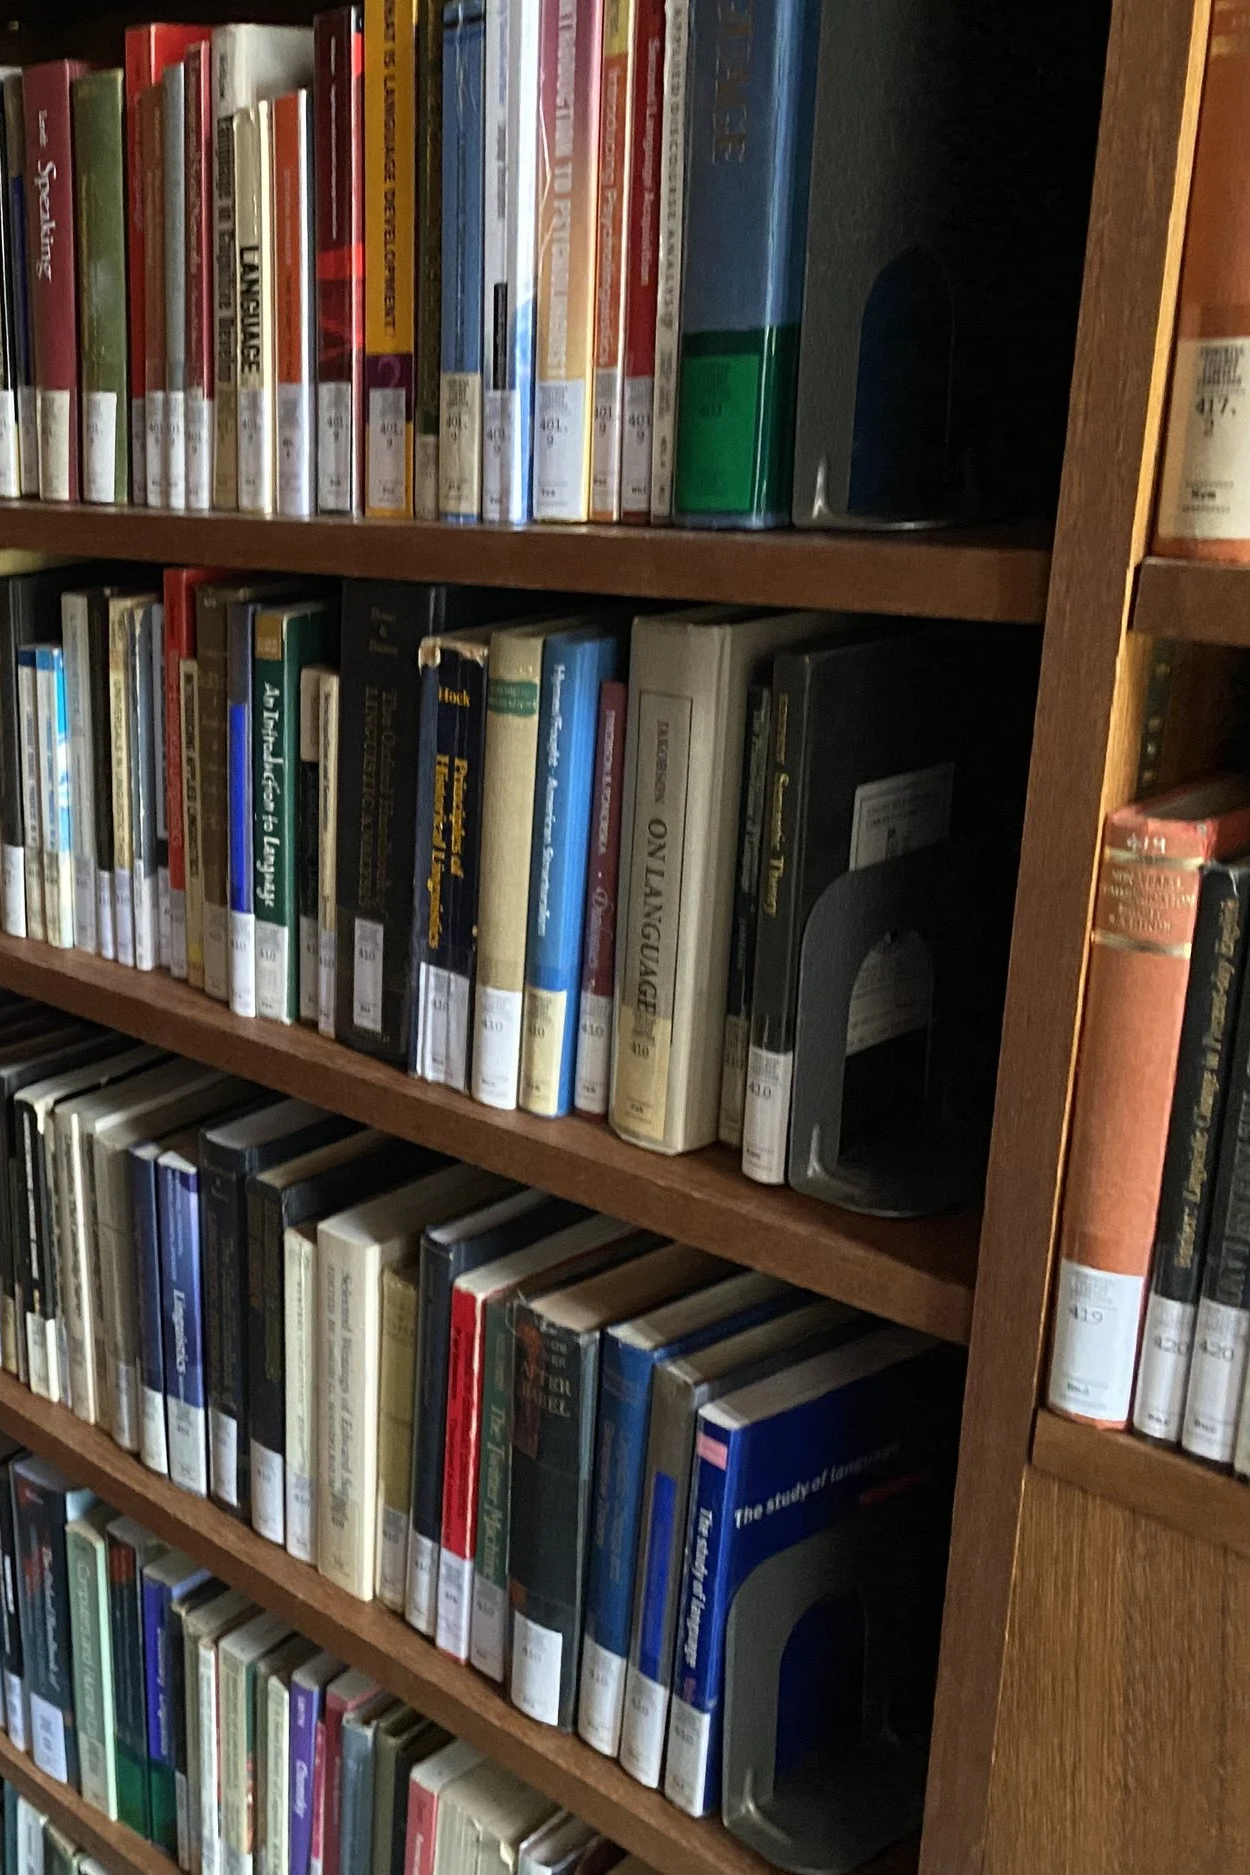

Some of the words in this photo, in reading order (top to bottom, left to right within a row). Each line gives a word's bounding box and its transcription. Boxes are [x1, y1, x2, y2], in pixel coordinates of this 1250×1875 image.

[215, 115, 234, 200] Language
[383, 75, 396, 181] LANGUAGE
[602, 67, 620, 186] Introducing
[642, 105, 657, 189] Language
[33, 159, 57, 284] Speaking
[640, 191, 655, 286] Acquisition
[217, 228, 235, 308] Cognitive
[383, 191, 396, 329] DEVELOPMENT
[597, 187, 617, 366] Psycholinguistics
[240, 245, 260, 374] LANGUAGE
[264, 682, 281, 709] An
[381, 689, 397, 724] The
[261, 709, 284, 812] Introduction
[362, 686, 378, 808] LINGUISTIC
[380, 730, 397, 794] Oxford
[653, 721, 670, 805] JAKOBSON
[261, 814, 279, 833] to
[431, 754, 450, 850] Historical
[448, 755, 468, 854] Principles
[770, 771, 790, 852] Semantic
[259, 835, 281, 908] Language
[376, 800, 395, 897] Handbook
[450, 853, 464, 879] of
[646, 818, 667, 864] ON
[426, 849, 445, 950] Linguistics
[763, 854, 785, 918] Theory
[358, 948, 375, 961] 410
[633, 866, 665, 1018] LANGUAGE
[1214, 899, 1241, 958] English
[481, 1018, 504, 1032] 410
[581, 1023, 605, 1037] 410
[631, 1043, 650, 1057] 410
[748, 1081, 772, 1098] 410
[1194, 1070, 1221, 1128] Change
[1183, 1130, 1210, 1204] Linguistic
[172, 1289, 188, 1374] Linguistics
[339, 1269, 353, 1333] Selected
[1069, 1304, 1103, 1325] 419
[1156, 1335, 1188, 1357] 420
[1203, 1339, 1235, 1361] 420
[340, 1396, 354, 1415] of
[490, 1403, 506, 1437] The
[340, 1417, 353, 1474] Edward
[486, 1440, 505, 1505] Twitter
[699, 1507, 713, 1537] The
[734, 1502, 763, 1529] The
[765, 1481, 811, 1515] study
[811, 1467, 830, 1492] of
[483, 1504, 503, 1580] Machine
[692, 1535, 710, 1582] study
[76, 1563, 92, 1637] Computers
[692, 1580, 706, 1602] of
[81, 1640, 94, 1665] and
[684, 1596, 705, 1669] language
